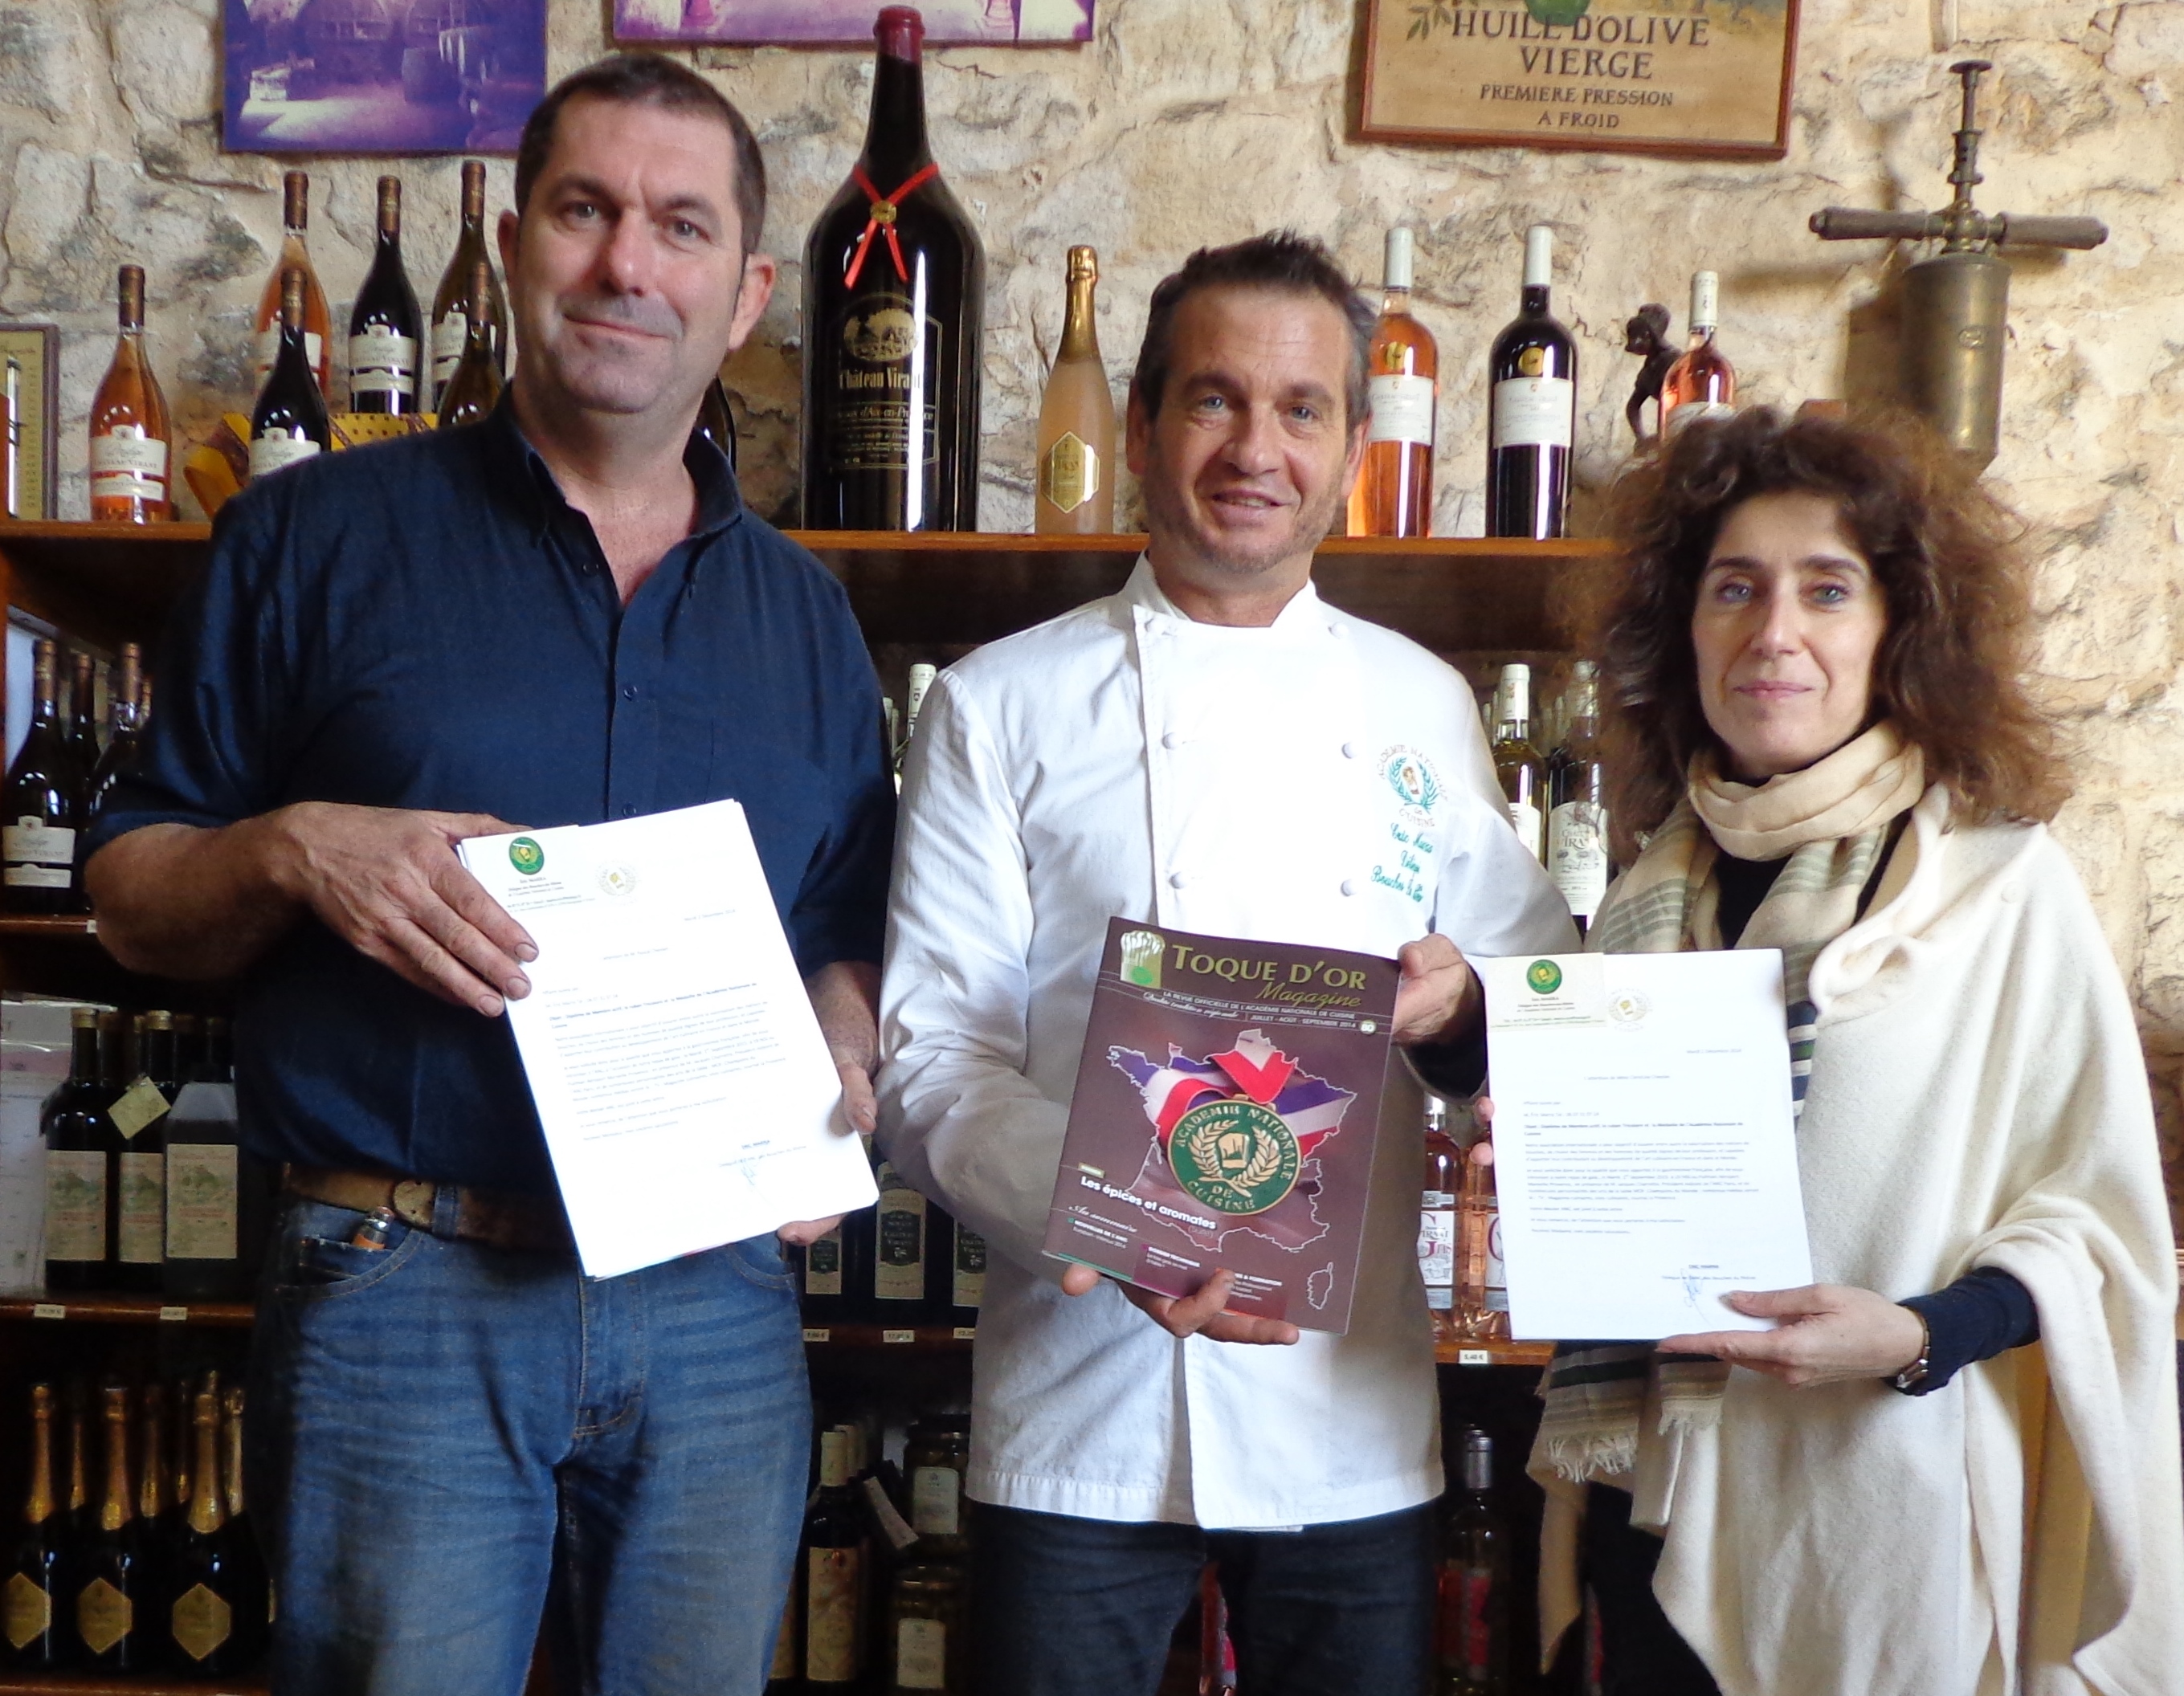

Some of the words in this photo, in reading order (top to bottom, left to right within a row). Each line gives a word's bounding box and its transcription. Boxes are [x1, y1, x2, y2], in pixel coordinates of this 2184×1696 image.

[1572, 14, 1710, 47] D'OLIVE
[1520, 45, 1655, 80] VIERGE
[1480, 84, 1577, 103] PREMIERE
[1582, 88, 1674, 107] PRESSION
[1537, 111, 1552, 125] A
[1558, 112, 1619, 128] FROID
[886, 367, 921, 389] Vira
[1171, 944, 1279, 982] TOQUE
[1288, 960, 1366, 990] D'OR
[1255, 981, 1362, 1009] Magazine
[1174, 1104, 1240, 1148] ACADEMIE
[1247, 1108, 1297, 1181] NATIONALE
[1080, 1176, 1101, 1191] Les
[1102, 1183, 1143, 1206] épices
[1144, 1200, 1157, 1211] et
[1158, 1205, 1217, 1230] aromates
[1186, 1180, 1255, 1211] CUISINE
[1211, 1184, 1234, 1199] DE
